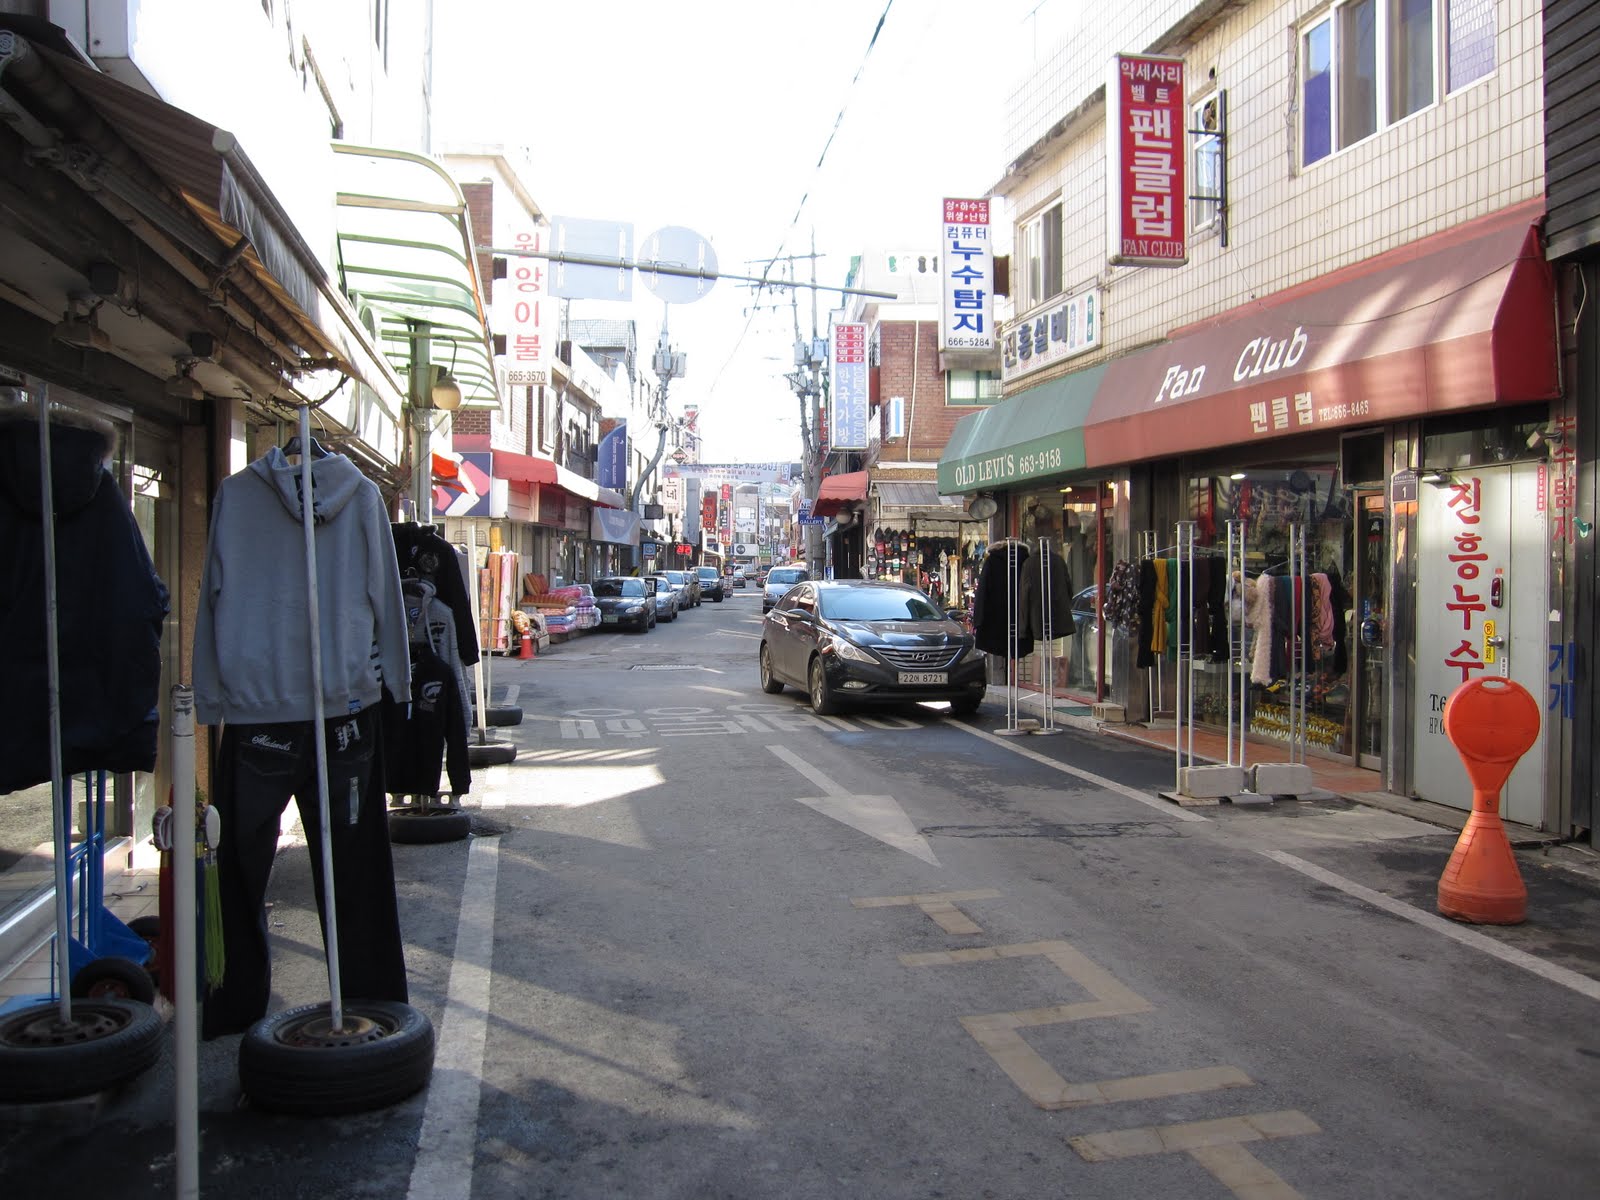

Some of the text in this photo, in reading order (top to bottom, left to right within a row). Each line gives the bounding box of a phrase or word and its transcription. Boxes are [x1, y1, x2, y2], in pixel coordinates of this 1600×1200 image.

[1121, 61, 1181, 84] 악세사리
[1129, 109, 1176, 237] 팬클럽
[947, 226, 987, 240] 컴퓨터
[1122, 238, 1183, 258] FAN CLUB
[513, 231, 543, 361] 원앙이불
[951, 240, 986, 333] 누수탐지
[948, 337, 990, 347] 666-5284
[508, 370, 546, 382] 665-3570
[1154, 325, 1309, 403] Fan Club
[837, 366, 851, 443] 한국가방
[1249, 391, 1314, 434] 팬클럽
[954, 446, 1062, 487] OLD LEVI'S 663-9158
[1402, 486, 1407, 498] 1
[1445, 477, 1488, 685] 진흥누수
[922, 674, 943, 683] 8721
